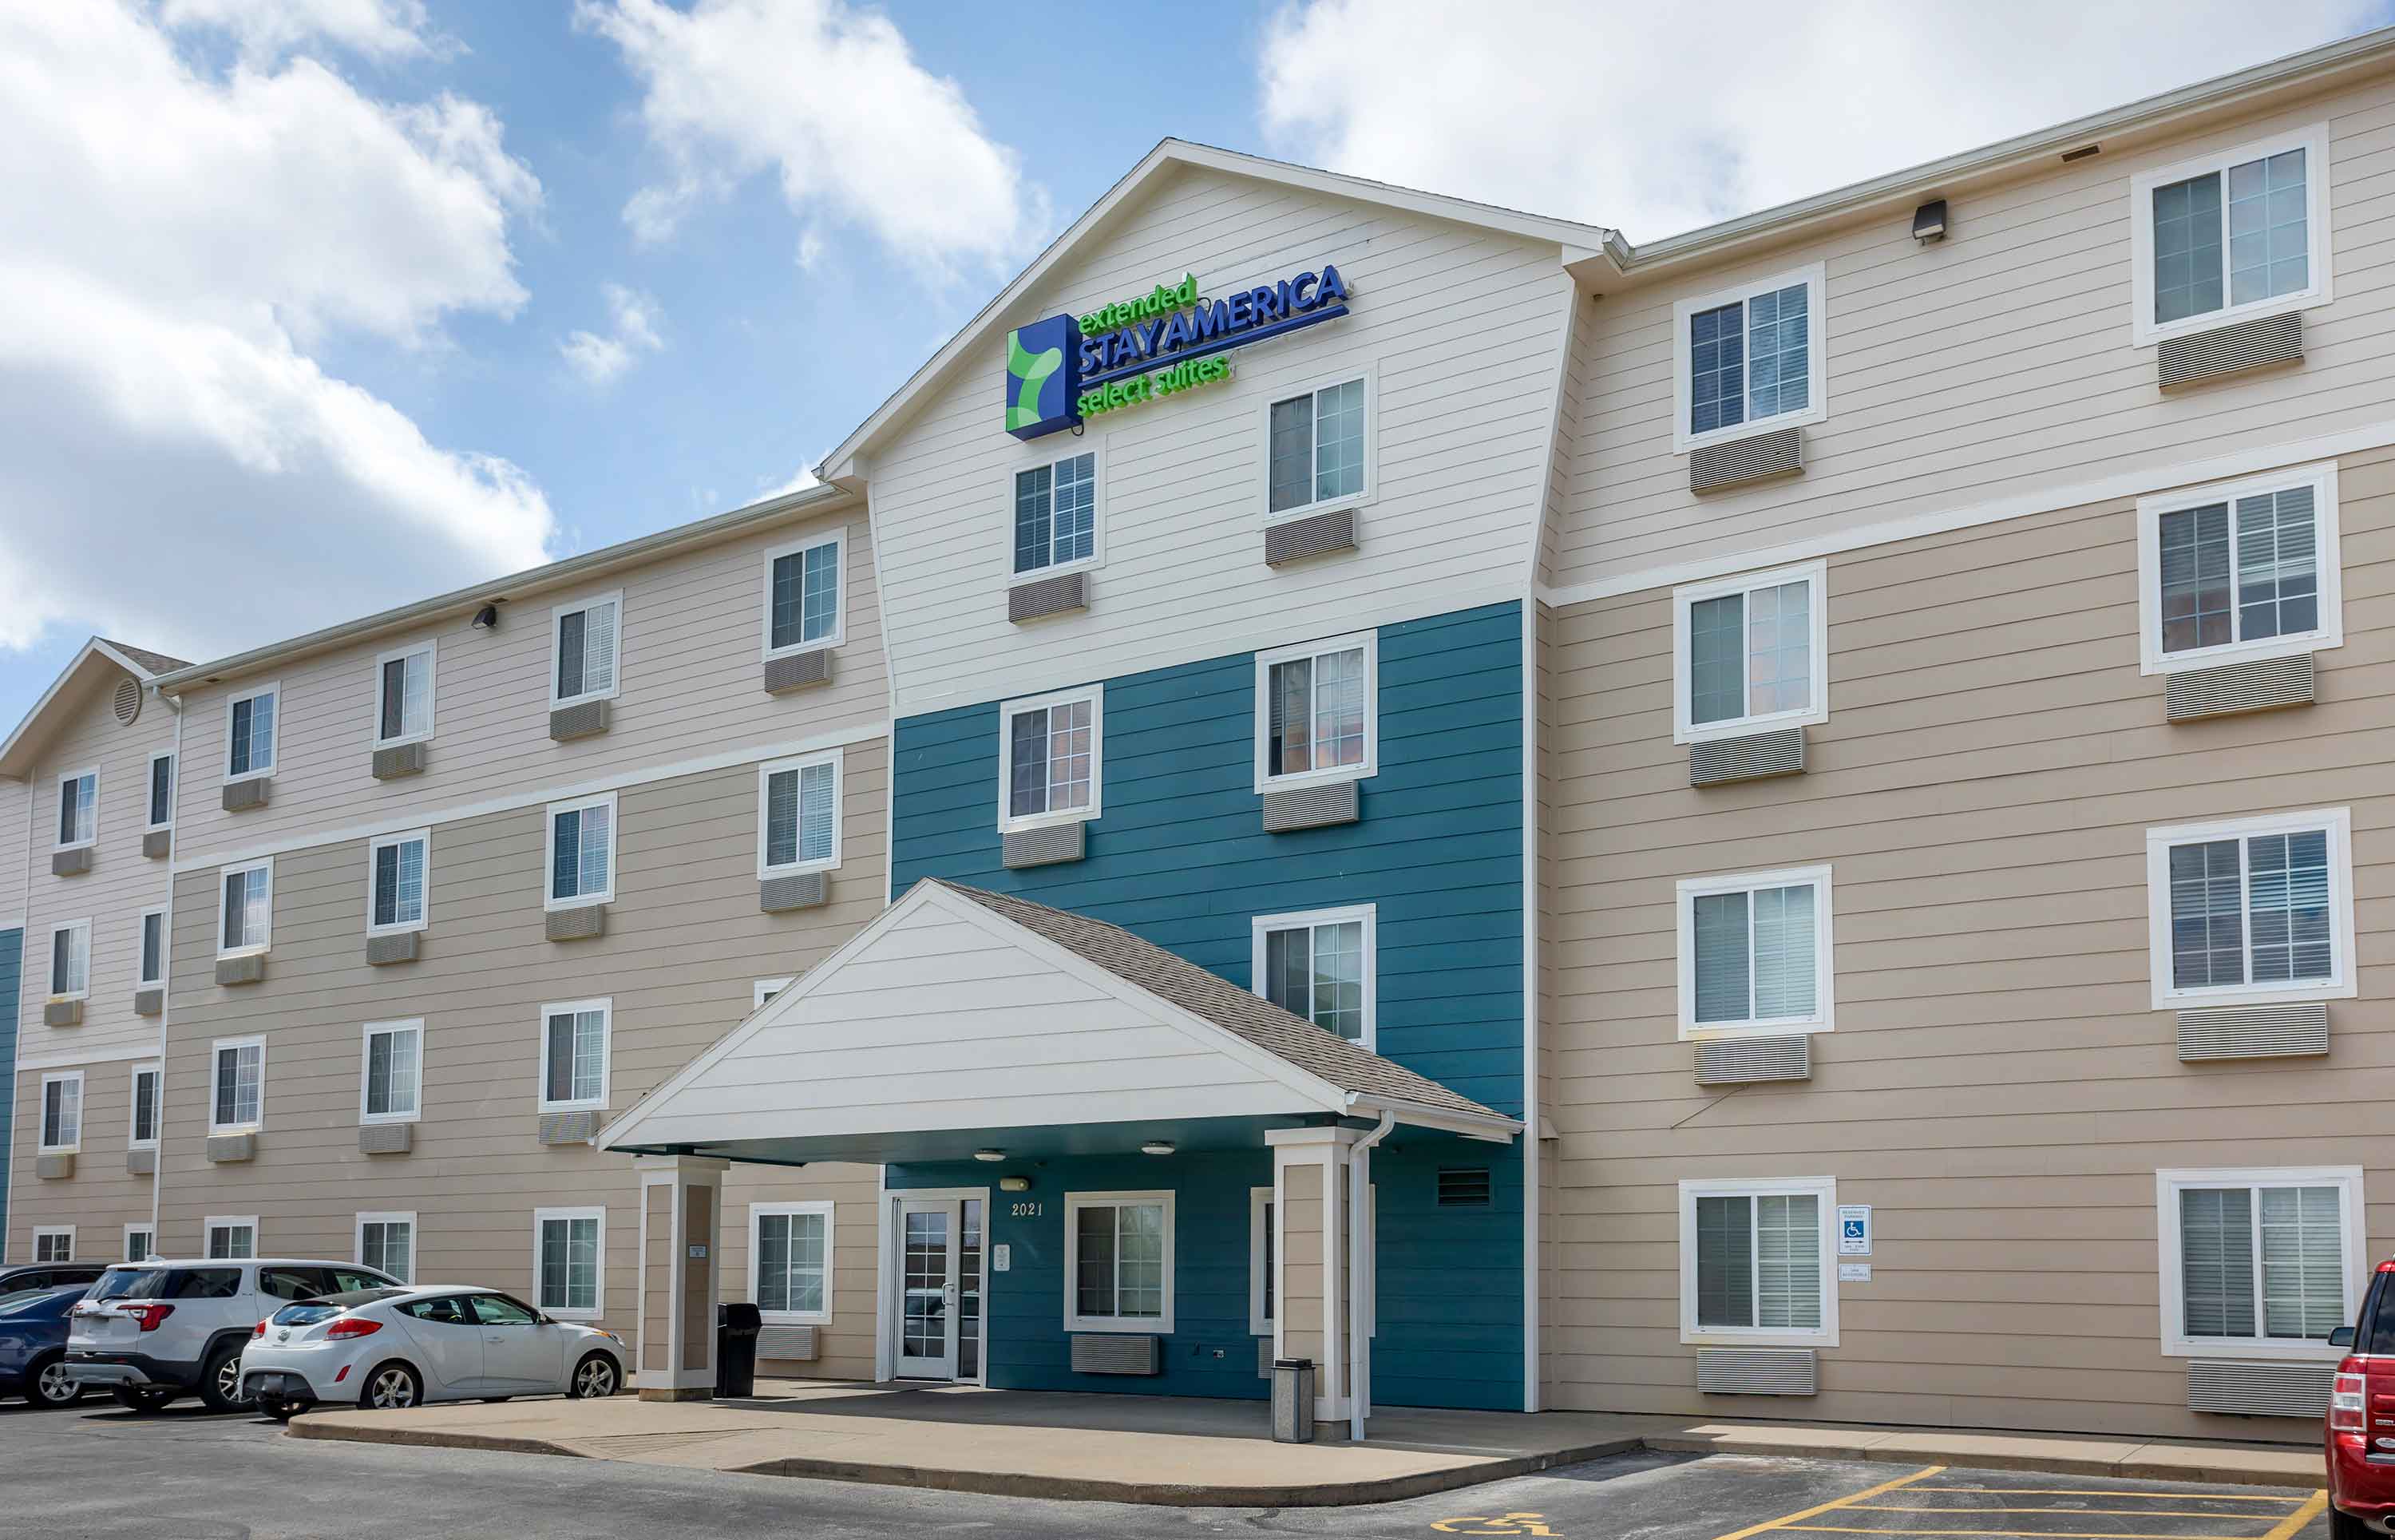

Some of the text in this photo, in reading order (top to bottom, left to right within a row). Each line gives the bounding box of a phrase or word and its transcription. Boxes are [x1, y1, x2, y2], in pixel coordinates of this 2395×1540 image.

[1079, 271, 1198, 337] extended
[1077, 355, 1230, 418] select suites
[1011, 1202, 1042, 1217] 2021
